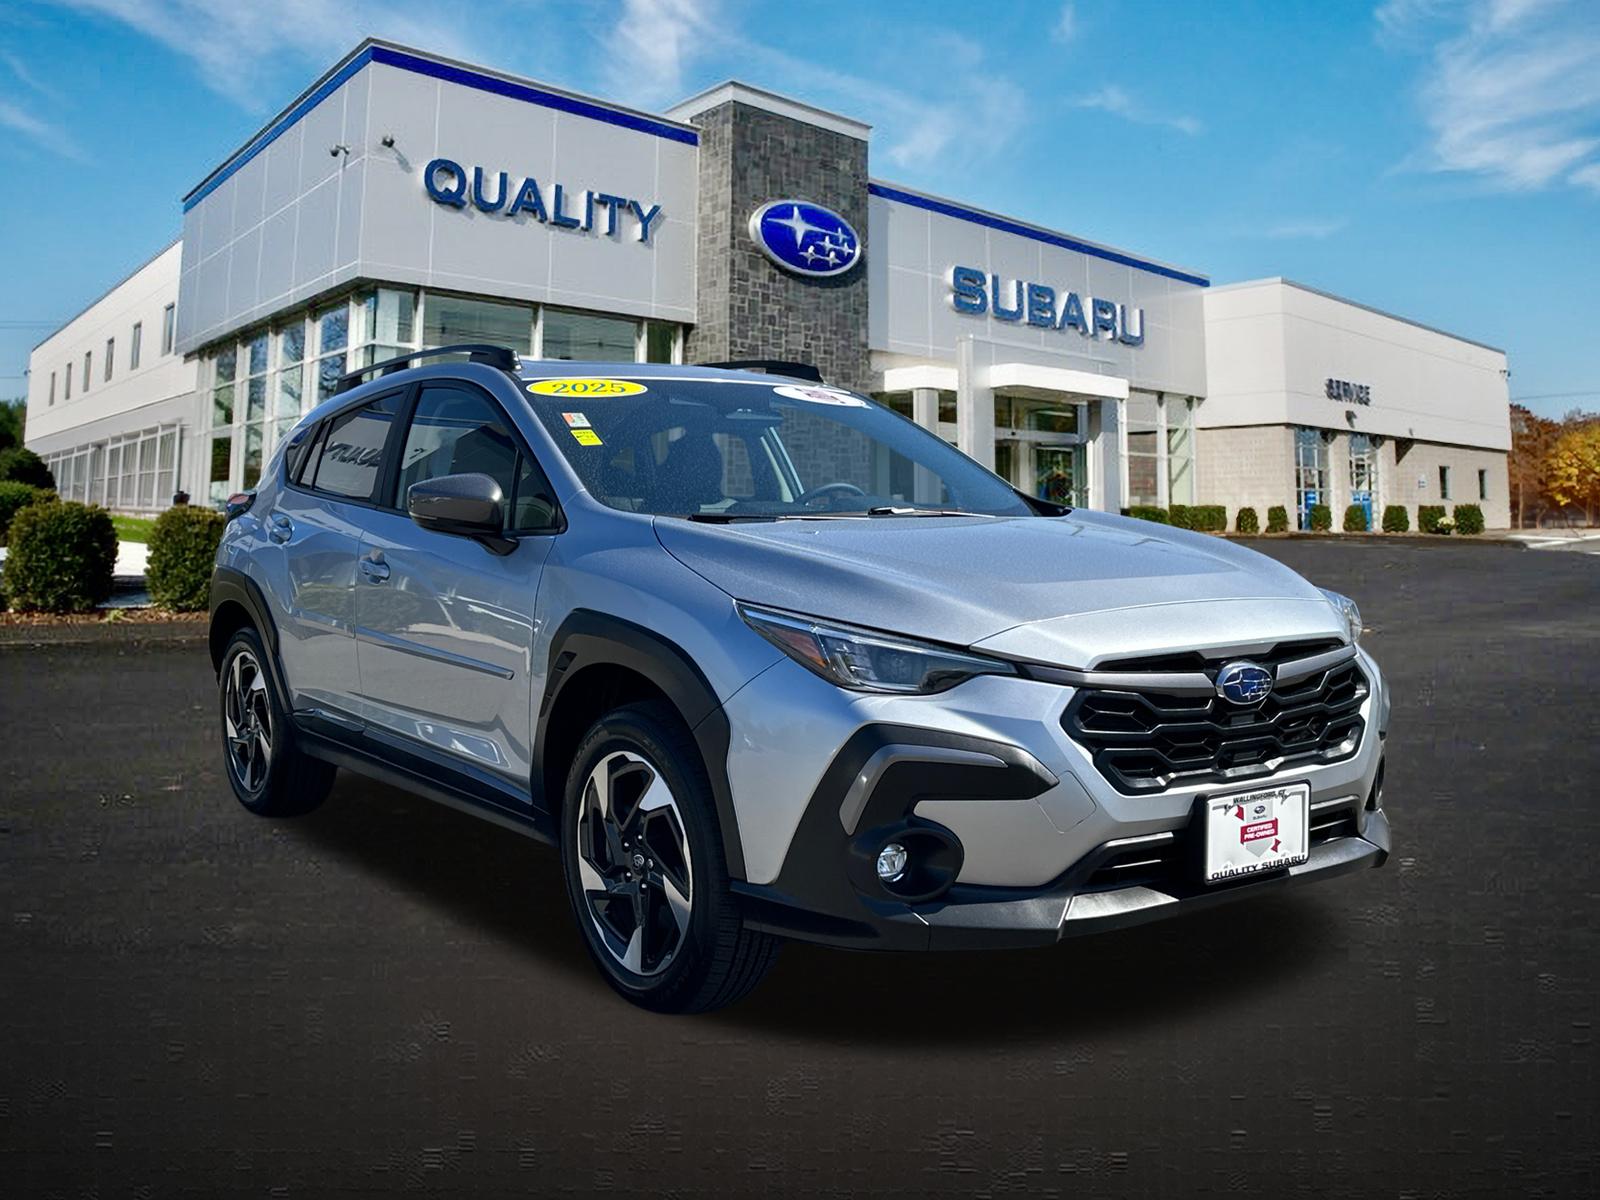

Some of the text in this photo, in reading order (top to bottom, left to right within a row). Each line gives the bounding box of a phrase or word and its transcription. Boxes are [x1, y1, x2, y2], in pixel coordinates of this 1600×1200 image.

[423, 158, 662, 243] QUALITY
[951, 265, 1145, 346] SUBARU
[552, 382, 627, 394] 2025
[1325, 378, 1371, 407] SERVICE
[1243, 828, 1276, 840] PRE-OWNED
[1211, 854, 1306, 880] QUALITY SUBARU
